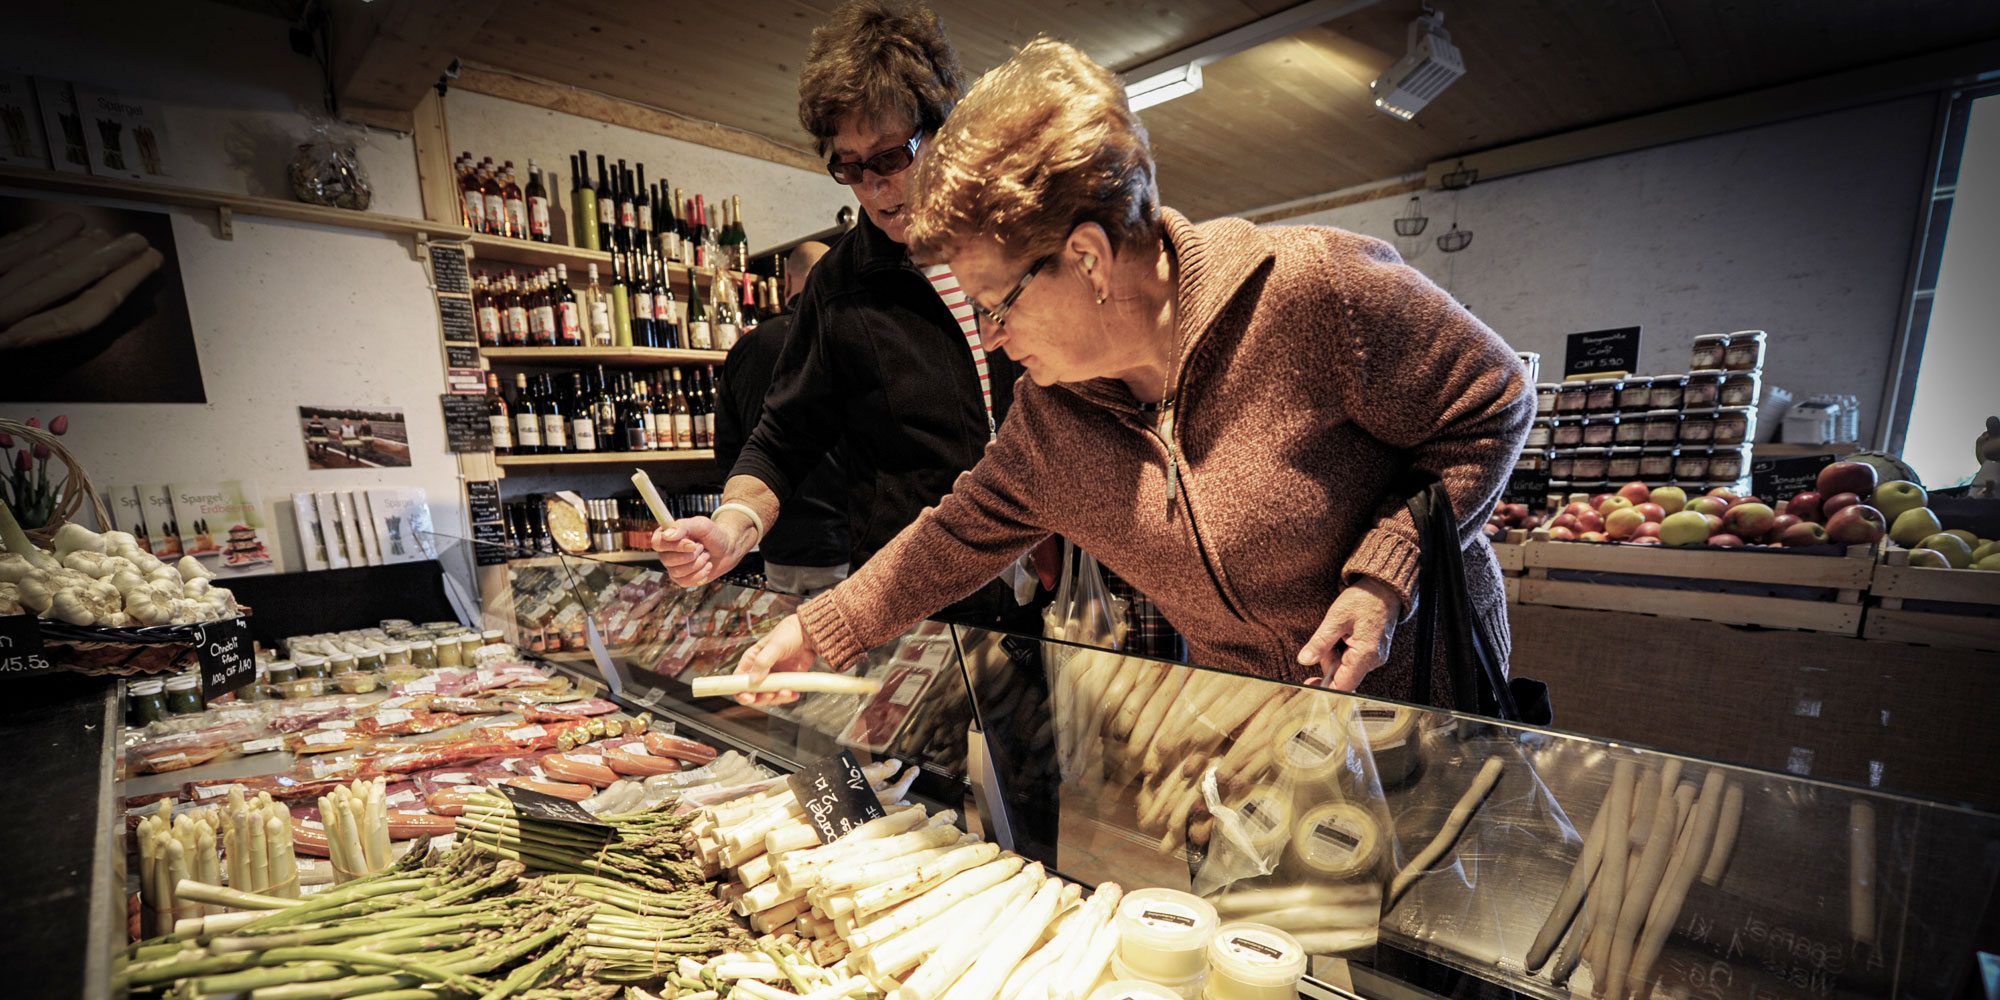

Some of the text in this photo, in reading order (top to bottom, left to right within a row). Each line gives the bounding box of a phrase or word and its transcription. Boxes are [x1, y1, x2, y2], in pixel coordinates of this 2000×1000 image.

[97, 97, 144, 117] Spargel
[181, 492, 223, 506] Spargel
[200, 503, 255, 514] Erdbeeren
[0, 654, 50, 671] 15.50
[806, 798, 838, 844] pargel
